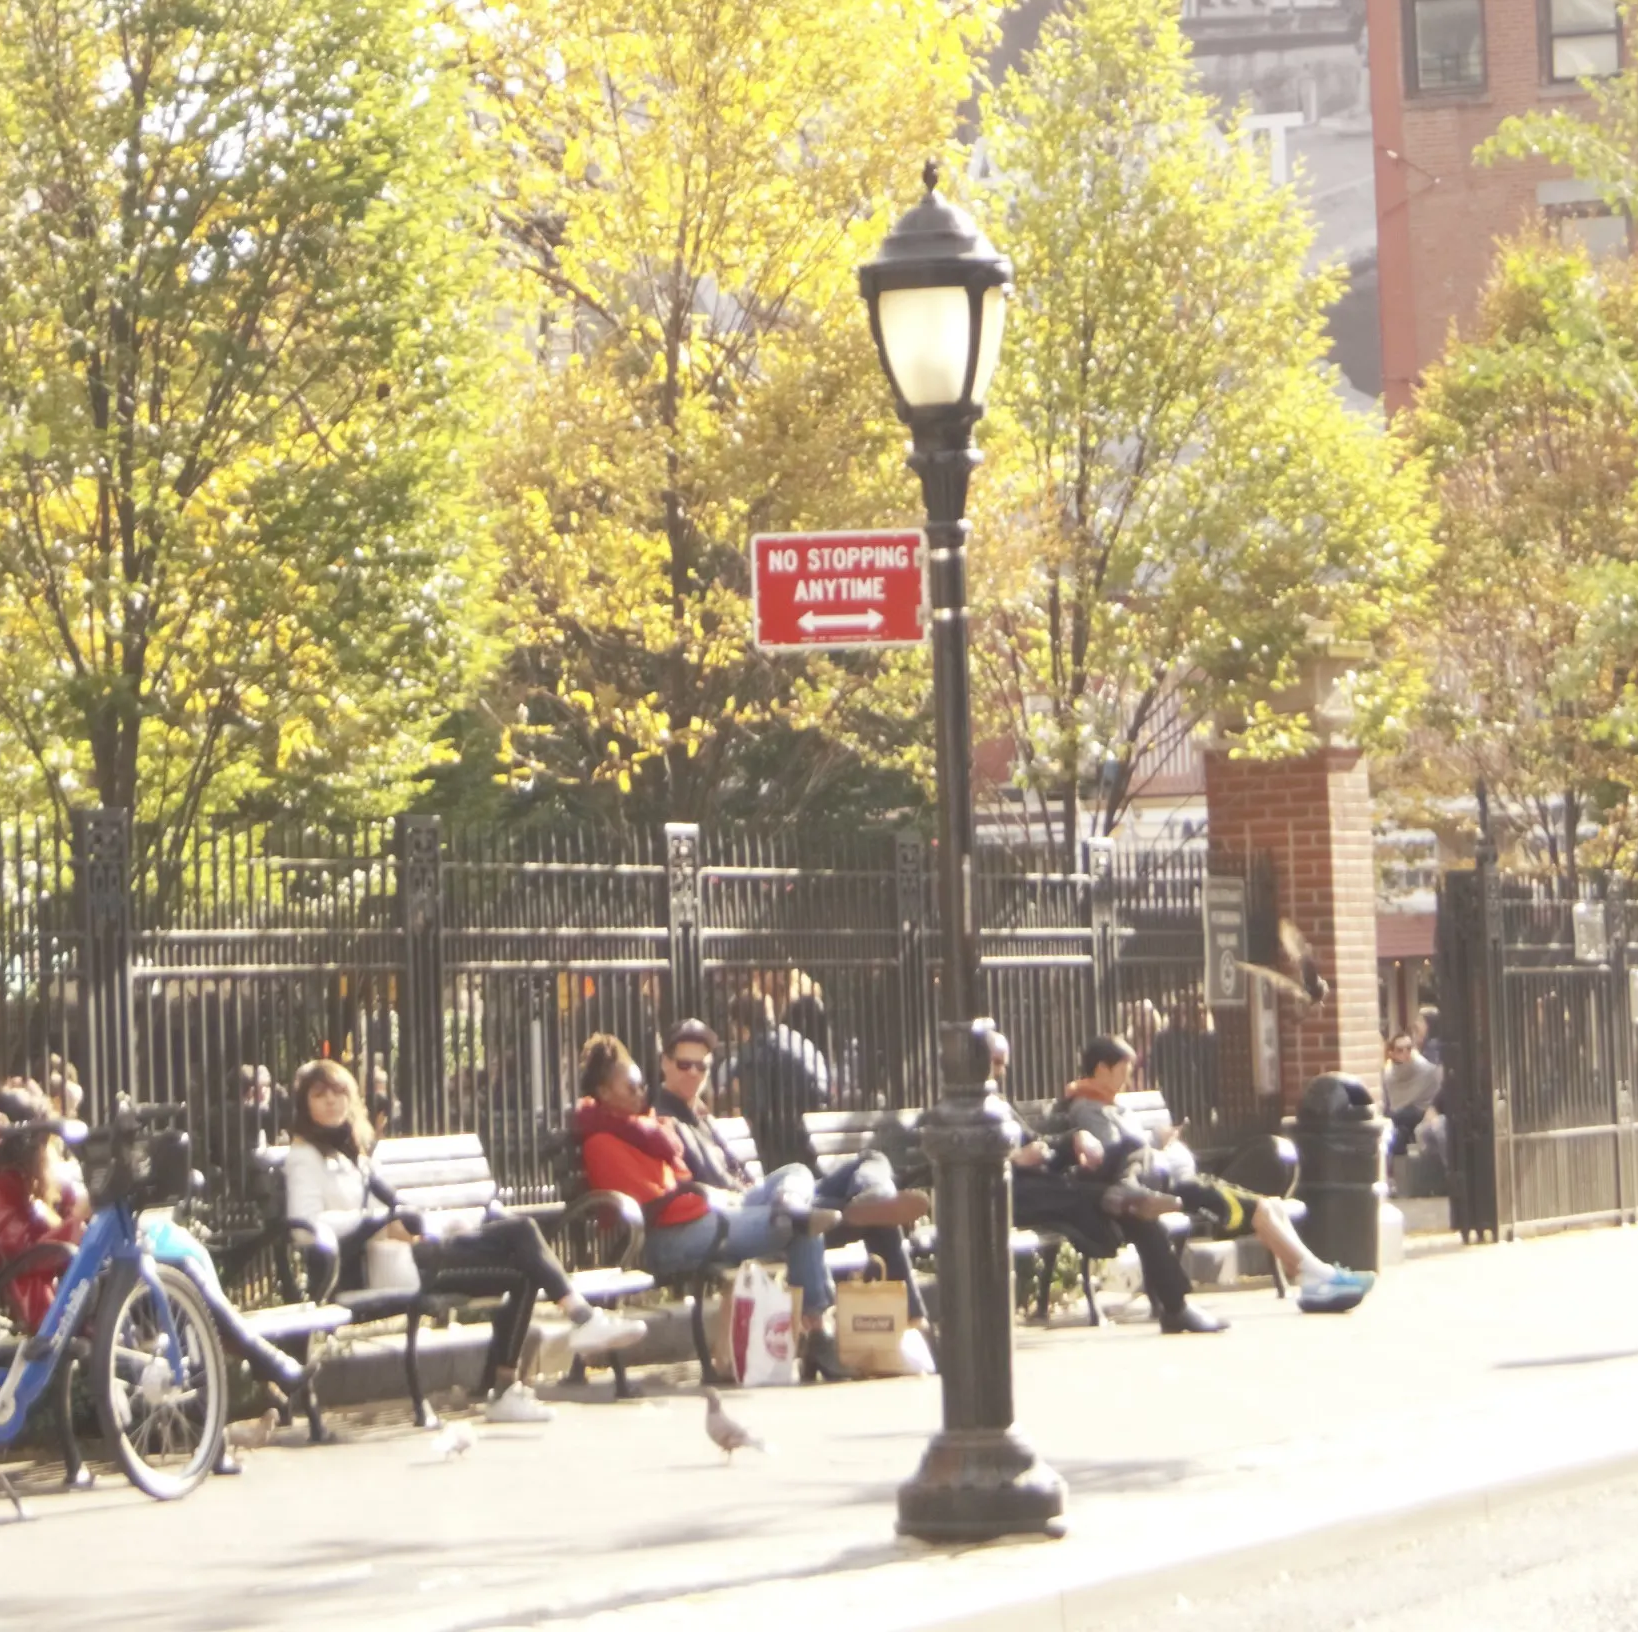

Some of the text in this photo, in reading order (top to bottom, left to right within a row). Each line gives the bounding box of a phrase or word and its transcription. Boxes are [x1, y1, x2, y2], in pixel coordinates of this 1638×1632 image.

[768, 545, 909, 573] NO STOPPING
[794, 577, 886, 602] ANYTIME
